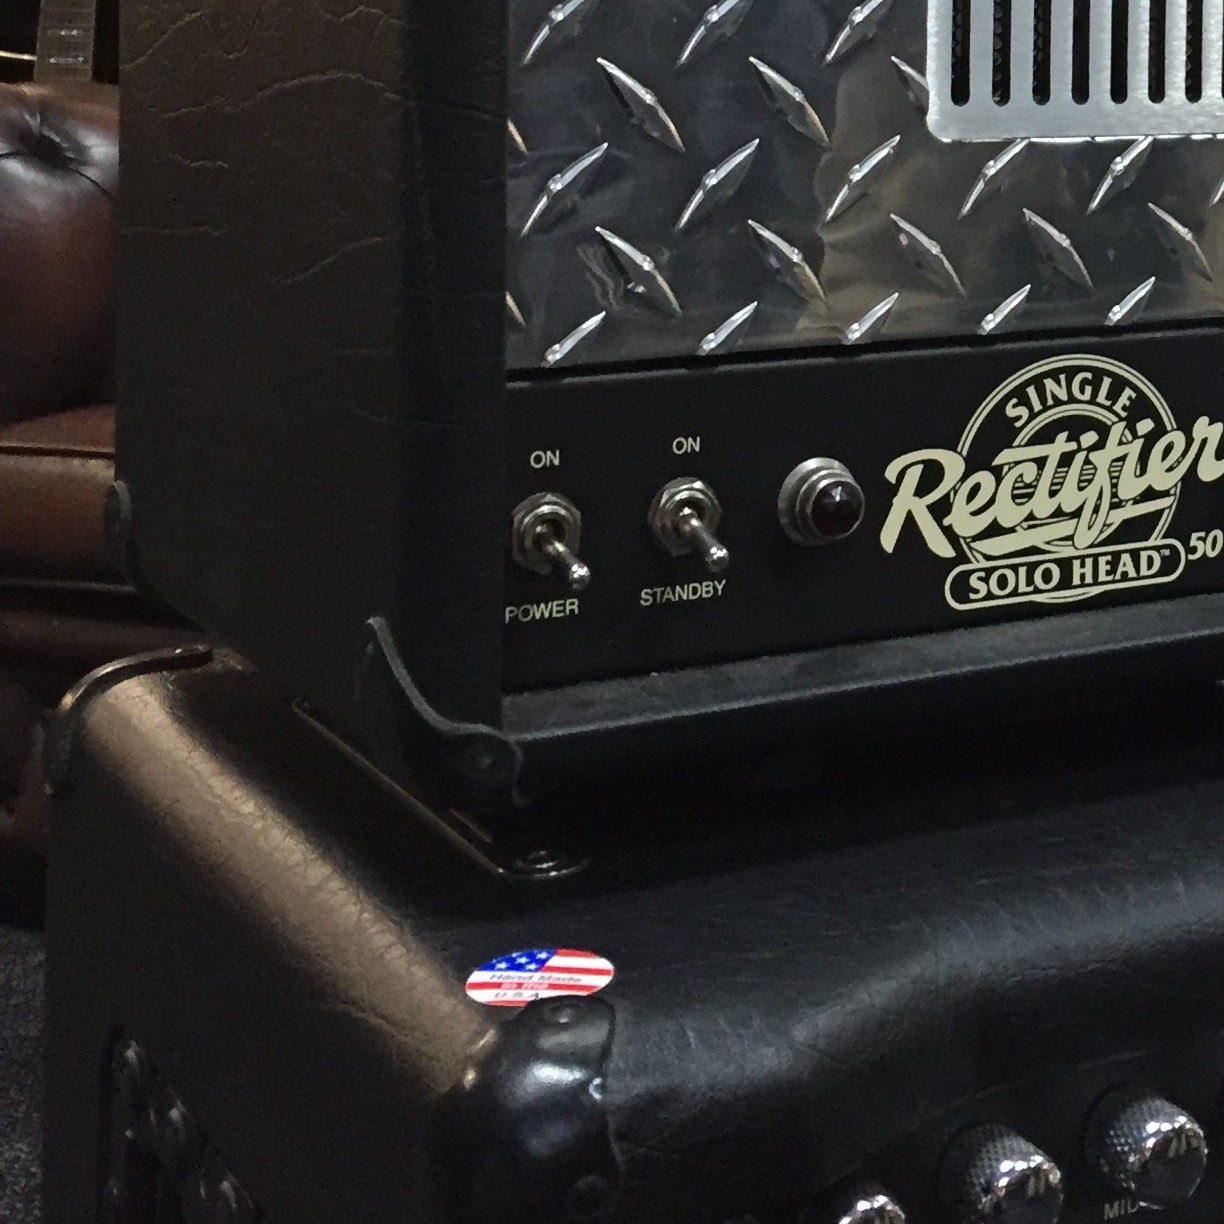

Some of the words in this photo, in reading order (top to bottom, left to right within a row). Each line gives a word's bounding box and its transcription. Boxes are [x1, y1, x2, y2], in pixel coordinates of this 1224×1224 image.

[1005, 371, 1138, 428] SINGLE
[529, 449, 560, 469] ON
[672, 436, 700, 455] ON
[1187, 529, 1224, 561] 50
[968, 561, 1061, 600] SOLO
[1071, 550, 1161, 587] HEAD
[639, 578, 727, 607] STANDBY
[504, 597, 579, 624] POWER
[489, 973, 534, 983] Hand
[537, 974, 582, 983] Made
